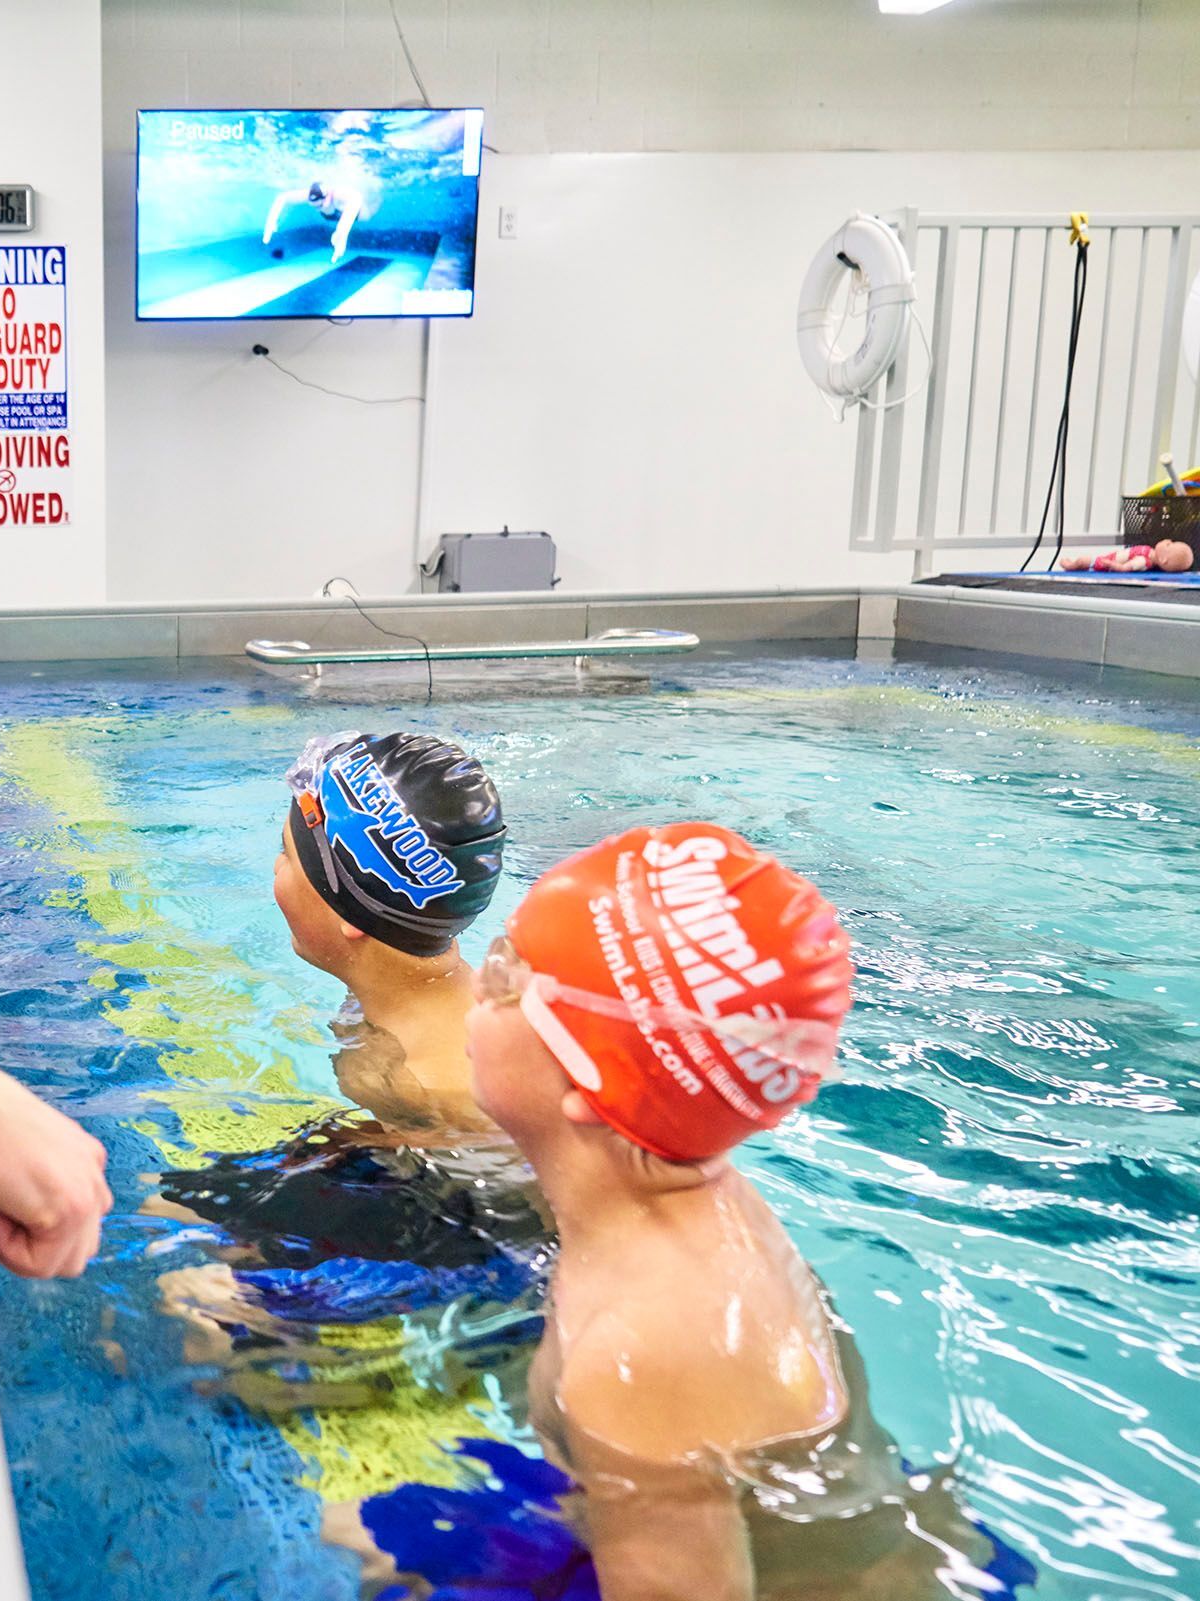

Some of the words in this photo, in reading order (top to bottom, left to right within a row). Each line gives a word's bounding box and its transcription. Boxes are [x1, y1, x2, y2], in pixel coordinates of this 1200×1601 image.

[171, 119, 245, 141] Paused
[10, 395, 25, 405] THE
[26, 394, 42, 404] AGE
[43, 394, 54, 404] OF
[56, 394, 65, 404] 14
[11, 406, 33, 416] POOL
[34, 406, 46, 416] OR
[47, 405, 63, 416] SPA
[10, 417, 19, 427] IN
[19, 417, 66, 428] ATTENDANCE
[335, 741, 458, 889] LAKEWOOD
[588, 895, 704, 1096] SwimLabs.com
